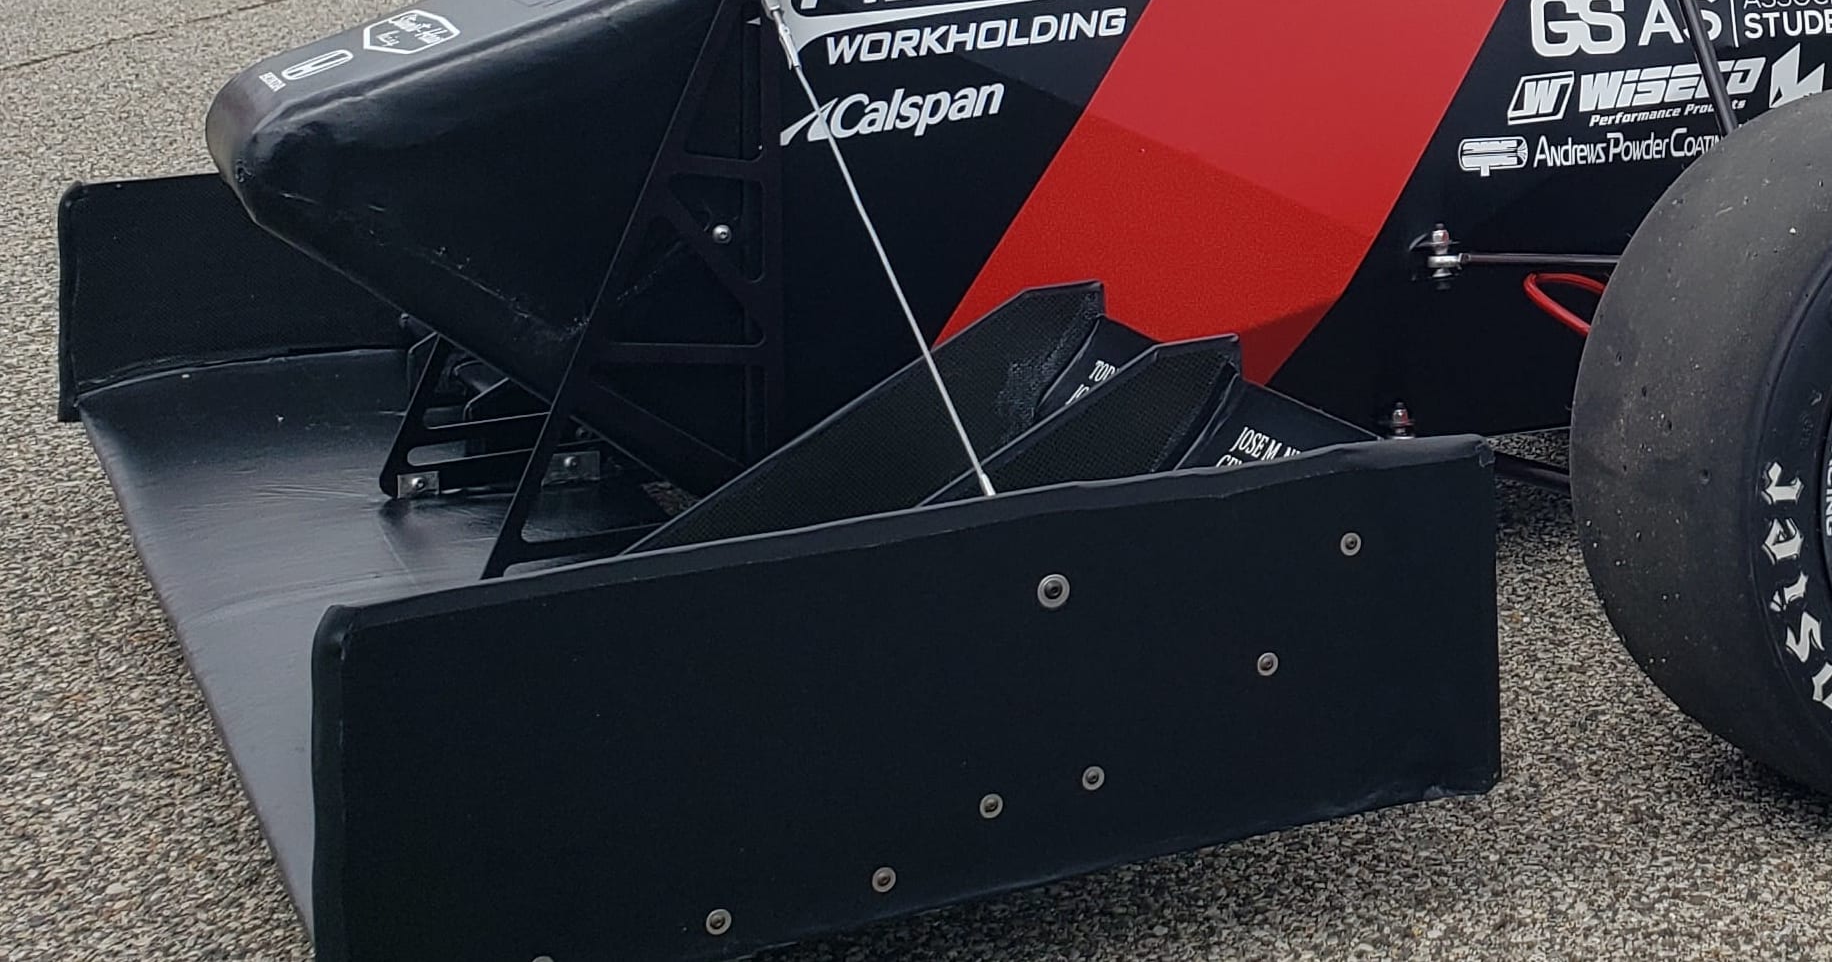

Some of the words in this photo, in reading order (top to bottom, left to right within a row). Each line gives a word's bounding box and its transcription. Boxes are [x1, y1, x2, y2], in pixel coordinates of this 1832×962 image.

[827, 8, 1128, 66] WORKHOLDING
[826, 82, 1005, 138] Calspan
[1588, 107, 1681, 128] Performance
[1683, 98, 1747, 117] Prots
[1533, 135, 1607, 168] Andrews
[1607, 132, 1668, 164] Powder
[1229, 426, 1270, 459] JOSE
